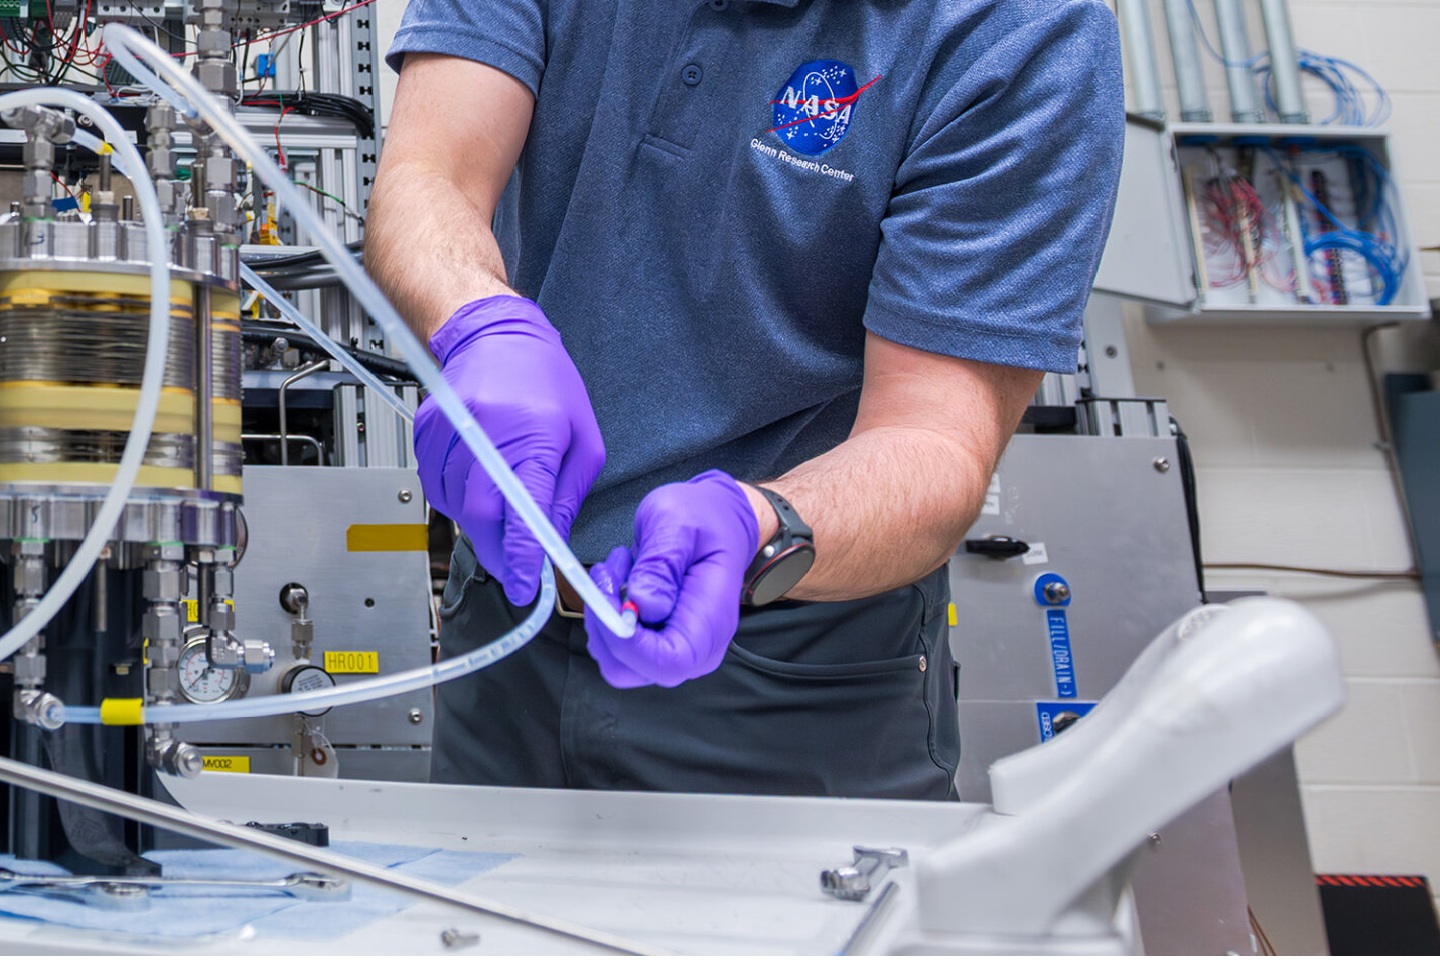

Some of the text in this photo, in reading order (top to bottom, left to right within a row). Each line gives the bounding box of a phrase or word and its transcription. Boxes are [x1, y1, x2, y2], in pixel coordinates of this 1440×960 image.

[780, 86, 852, 125] NASA
[750, 138, 855, 182] Glenn Research Center
[328, 653, 372, 670] HR001
